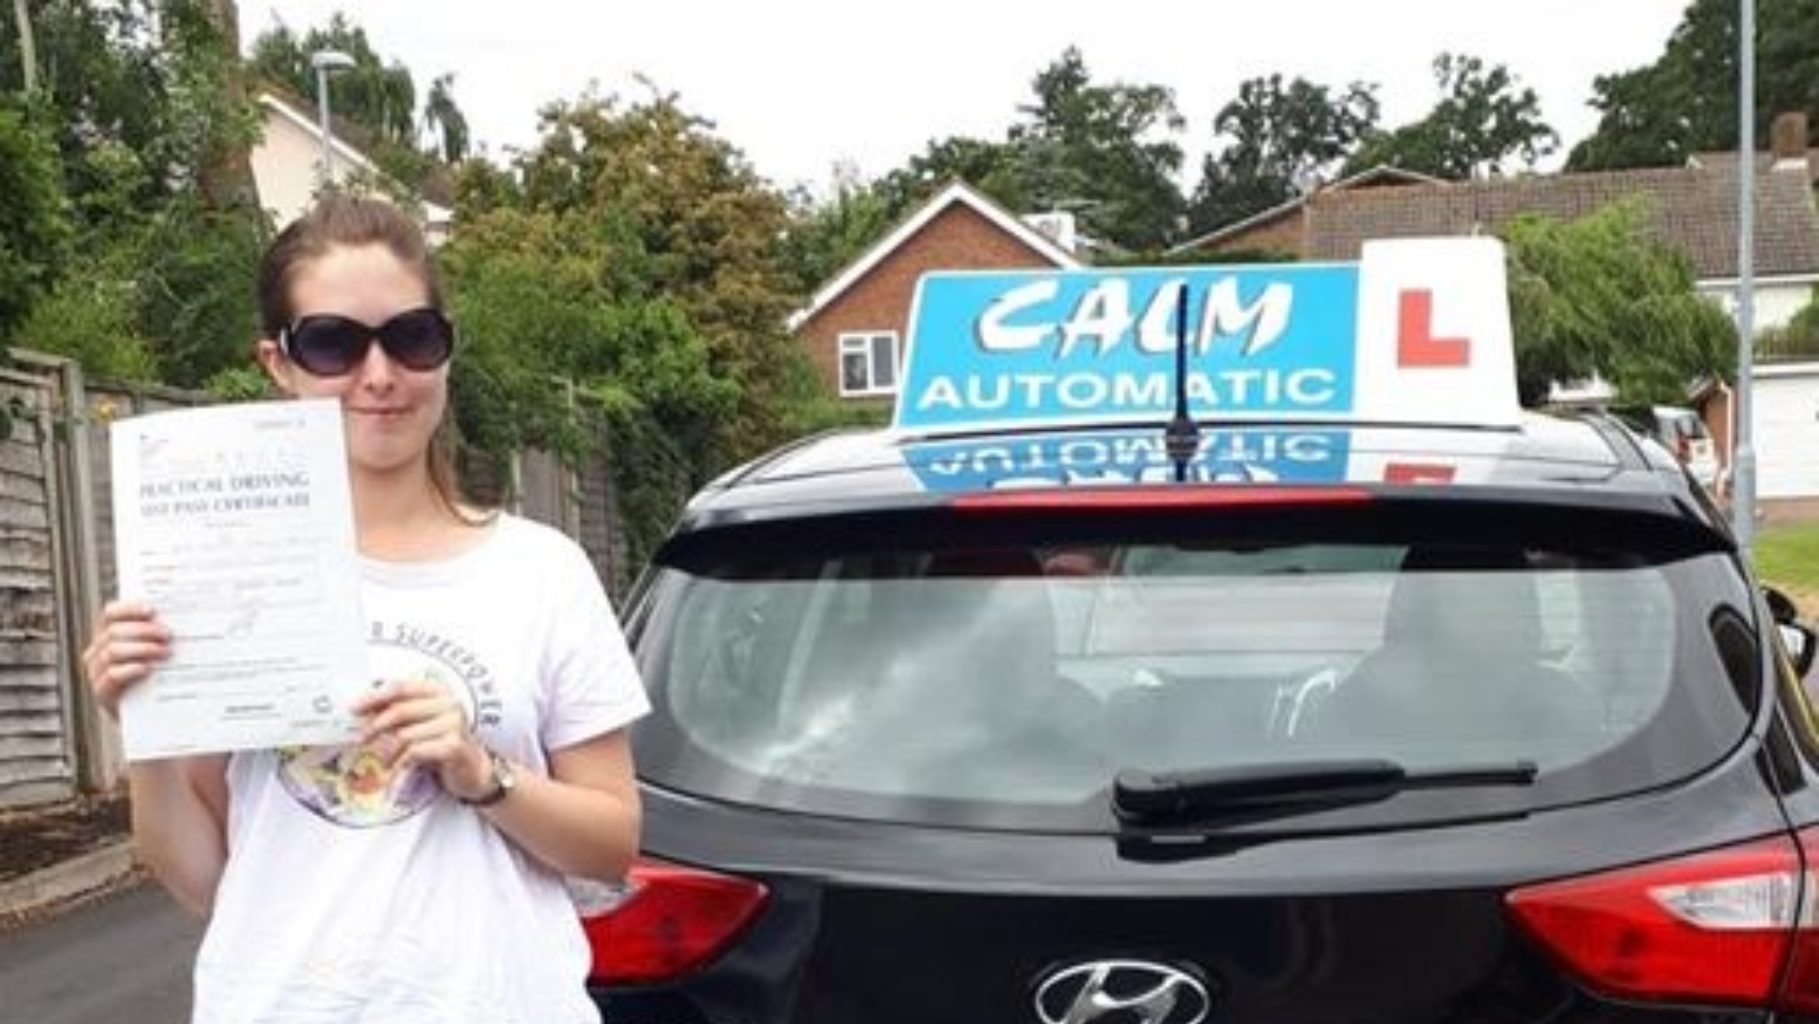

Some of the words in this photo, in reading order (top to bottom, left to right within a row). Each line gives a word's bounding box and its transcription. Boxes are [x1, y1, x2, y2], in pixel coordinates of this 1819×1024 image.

[974, 275, 1294, 359] CALM
[1397, 288, 1470, 367] L
[917, 368, 1336, 411] AUTOMATIC
